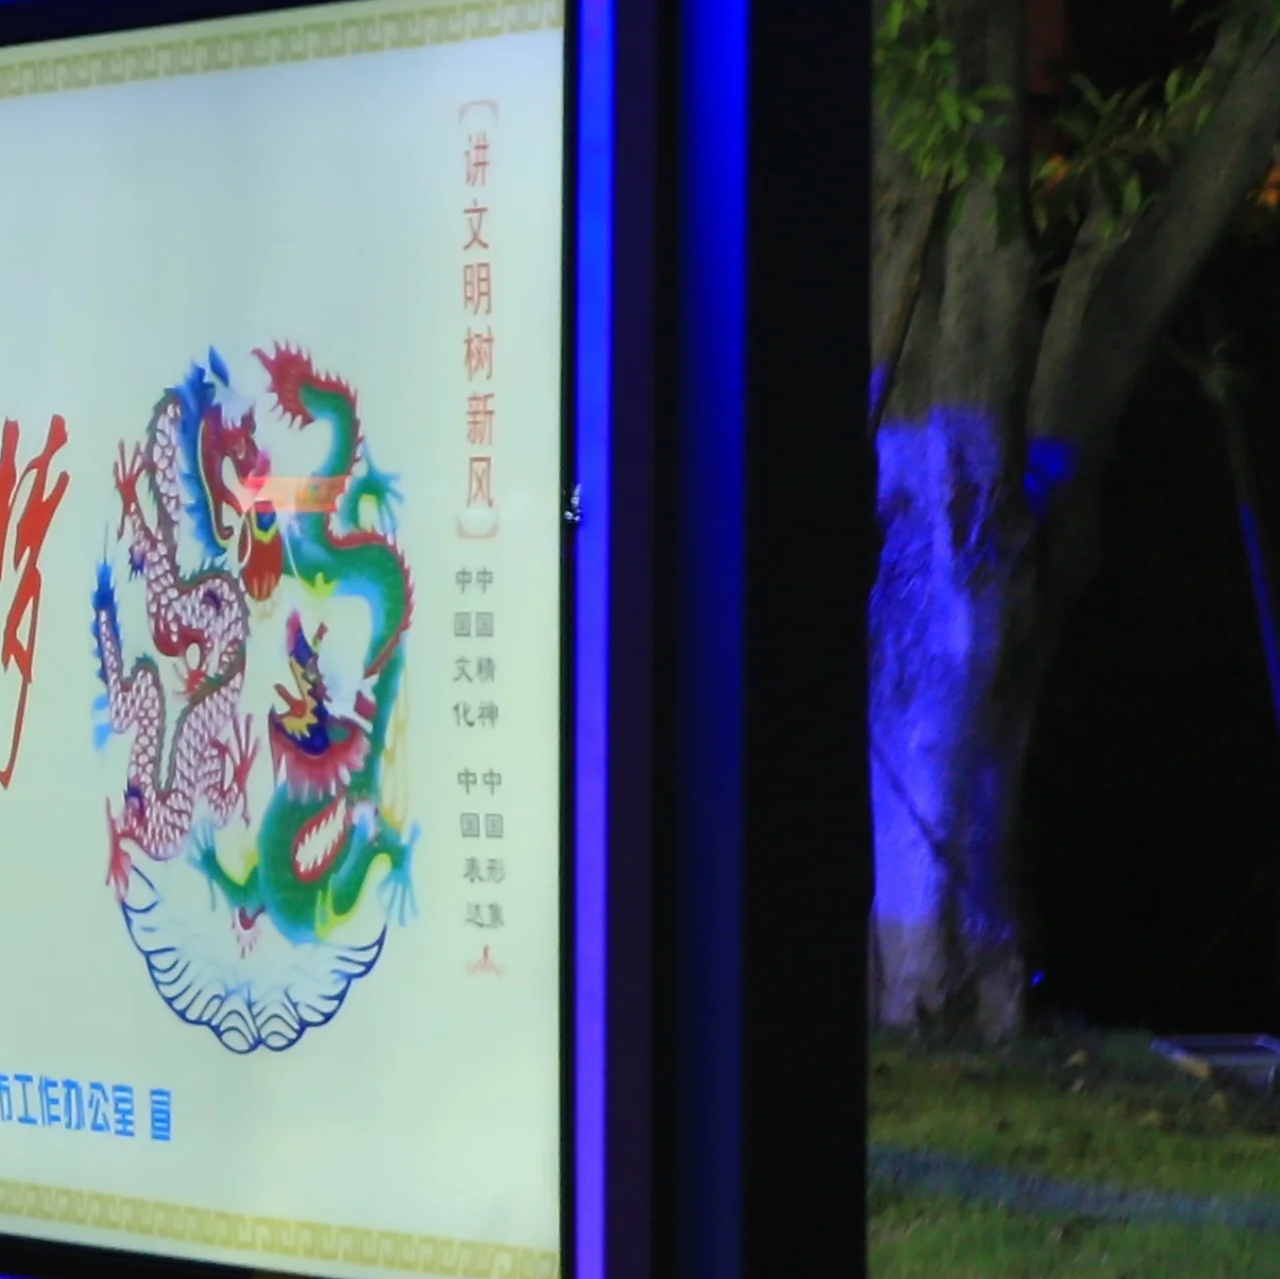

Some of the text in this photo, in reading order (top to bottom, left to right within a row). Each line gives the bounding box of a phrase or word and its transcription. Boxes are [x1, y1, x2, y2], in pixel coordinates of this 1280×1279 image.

[463, 132, 495, 510] 讲文明树新风
